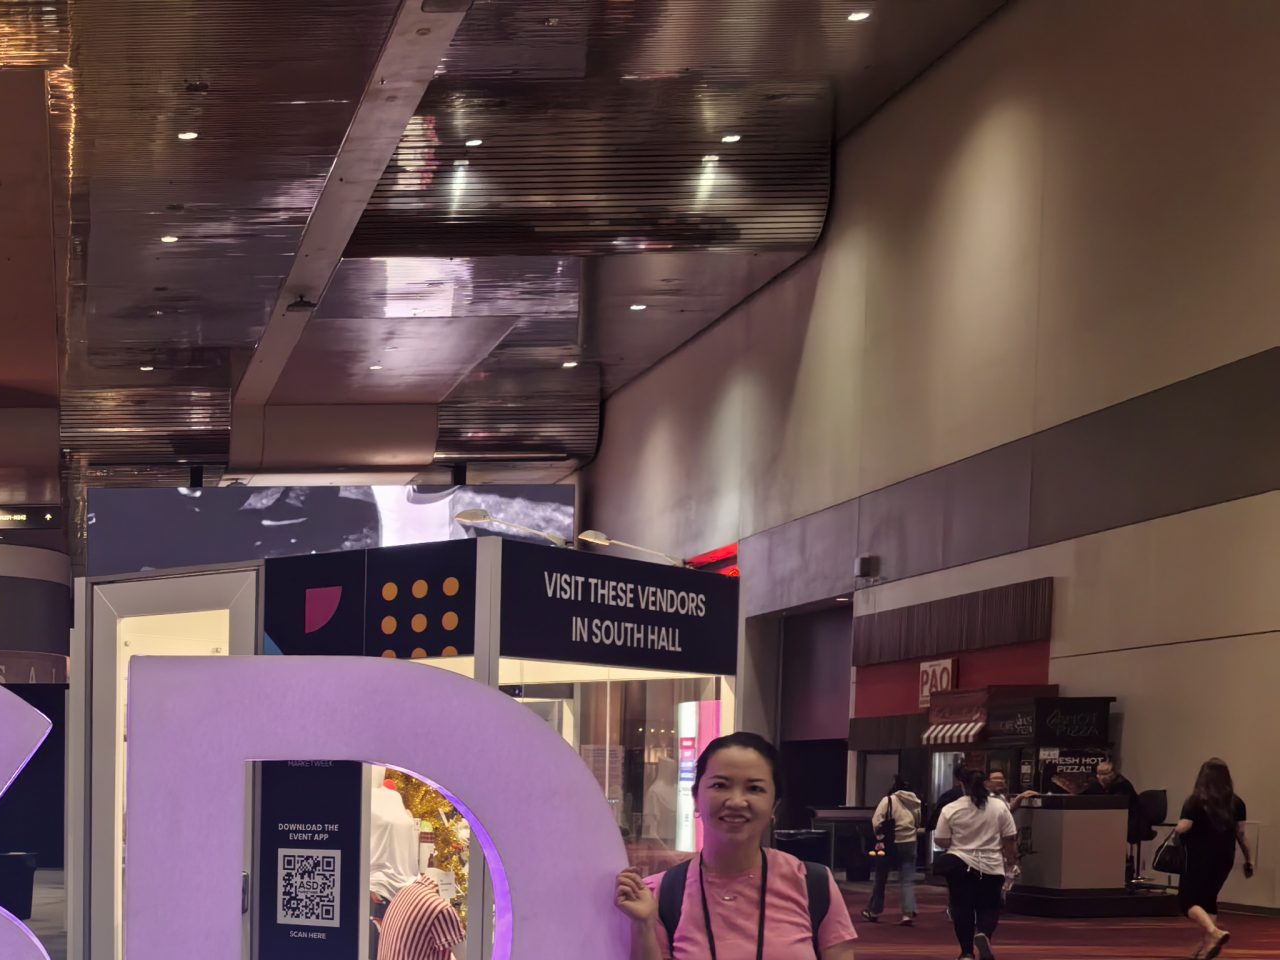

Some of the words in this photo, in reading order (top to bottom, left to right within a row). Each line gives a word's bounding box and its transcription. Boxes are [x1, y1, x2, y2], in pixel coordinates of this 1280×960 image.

[544, 571, 585, 601] VISIT
[588, 578, 635, 608] THESE
[638, 585, 706, 617] VENDORS
[572, 616, 588, 642] IN
[592, 619, 645, 649] SOUTH
[648, 626, 682, 652] HALL
[278, 823, 323, 832] DOWNLOAD
[324, 823, 339, 832] THE
[289, 833, 313, 841] EVENT
[314, 833, 329, 841] APP
[298, 880, 319, 890] ASD
[289, 930, 308, 939] SCAN
[308, 931, 327, 940] HERE
